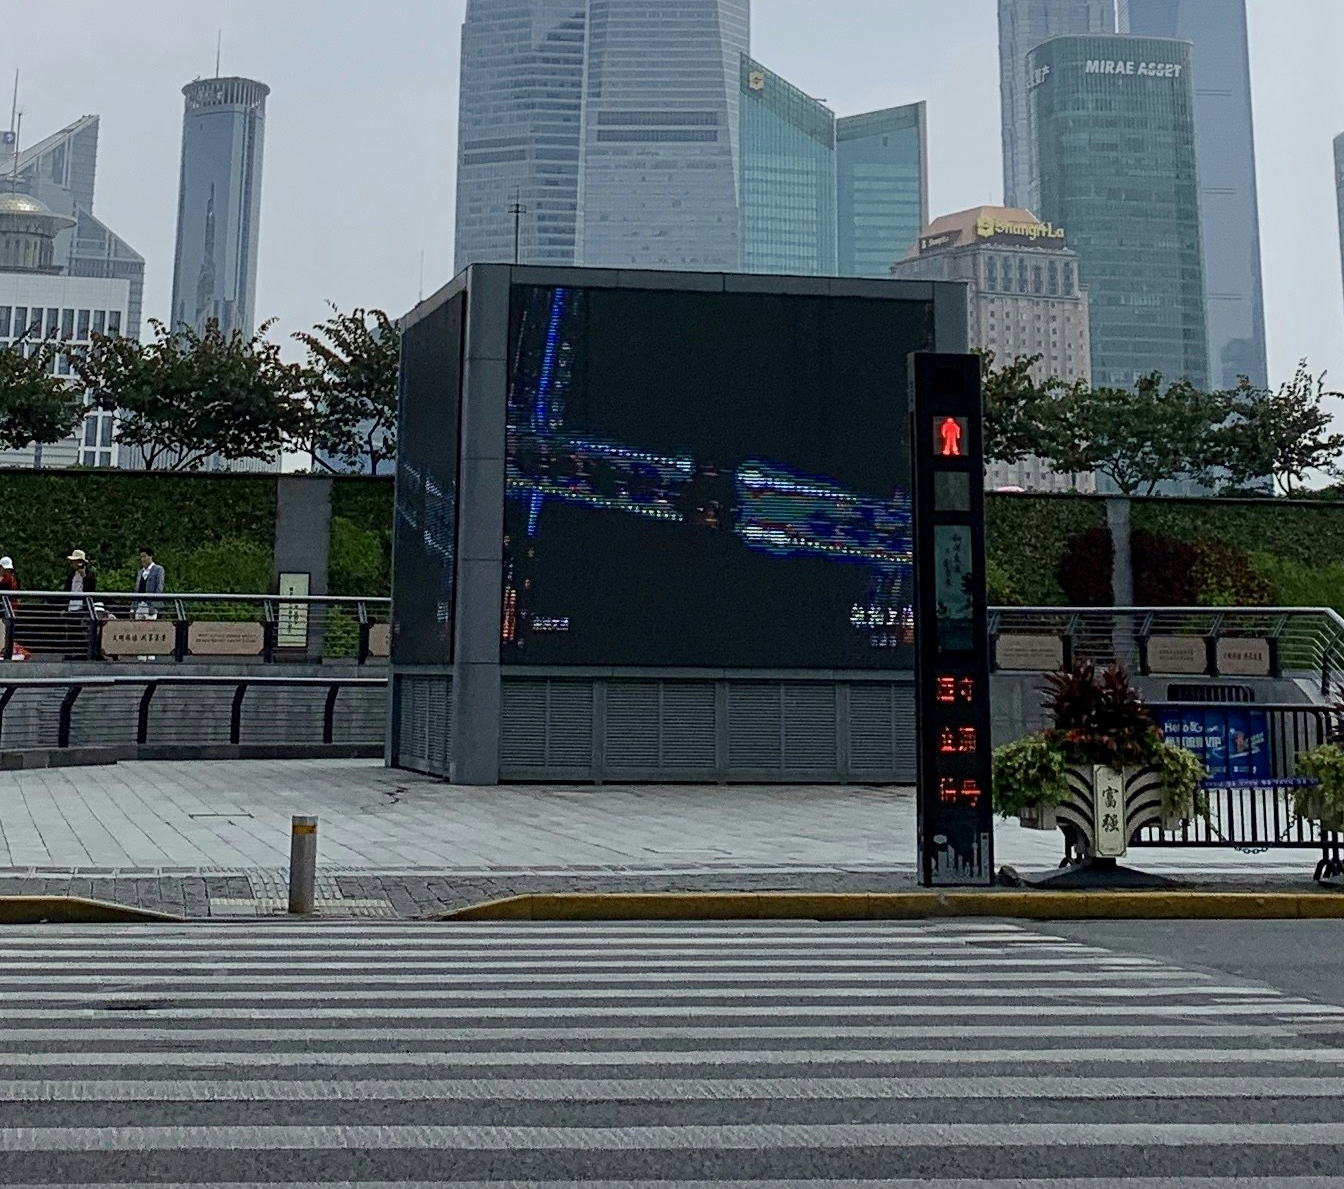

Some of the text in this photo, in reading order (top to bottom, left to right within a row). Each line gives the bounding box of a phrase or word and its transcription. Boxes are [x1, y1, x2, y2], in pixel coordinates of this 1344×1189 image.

[1086, 60, 1182, 77] MIRAE ASSET
[1102, 786, 1119, 832] 富强
